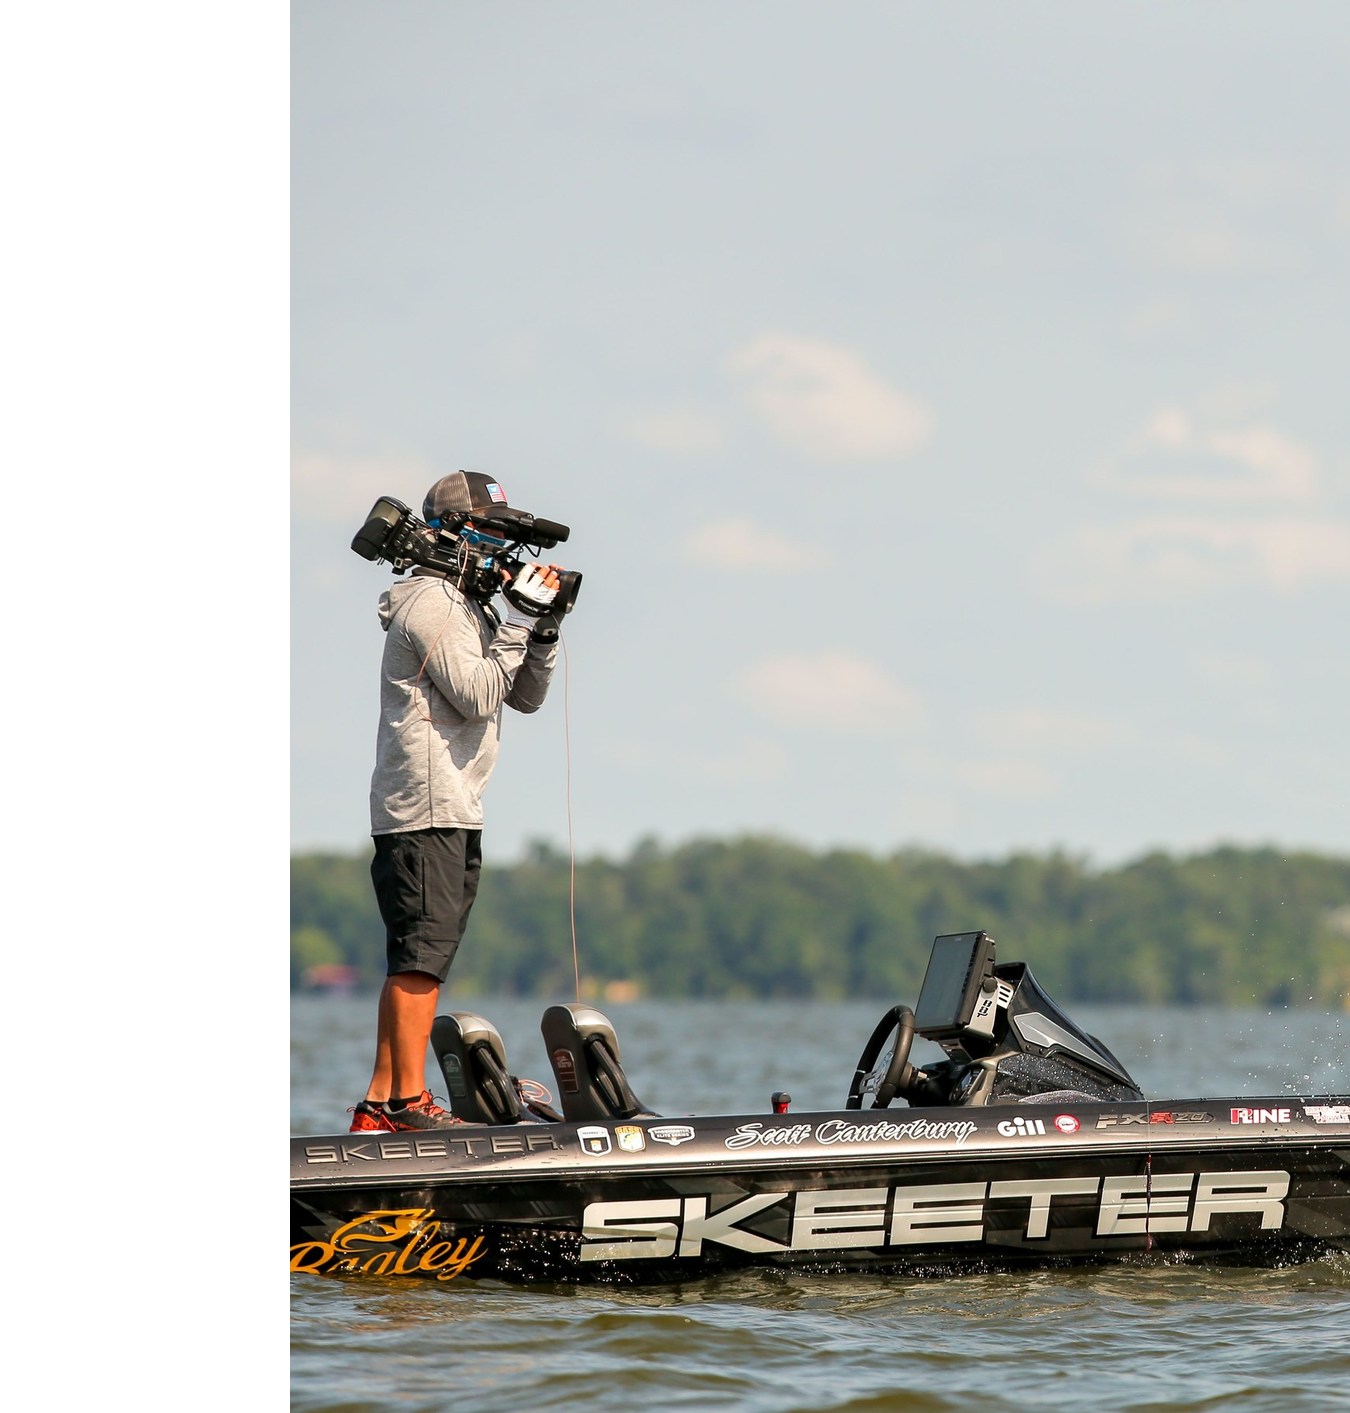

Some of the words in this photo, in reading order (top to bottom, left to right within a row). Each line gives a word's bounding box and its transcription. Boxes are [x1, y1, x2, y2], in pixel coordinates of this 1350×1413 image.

[725, 1122, 812, 1150] Scott
[815, 1118, 978, 1147] Canterbury
[997, 1116, 1047, 1137] Gill
[304, 1133, 564, 1165] SKEETER
[580, 1170, 1291, 1262] SKEETER
